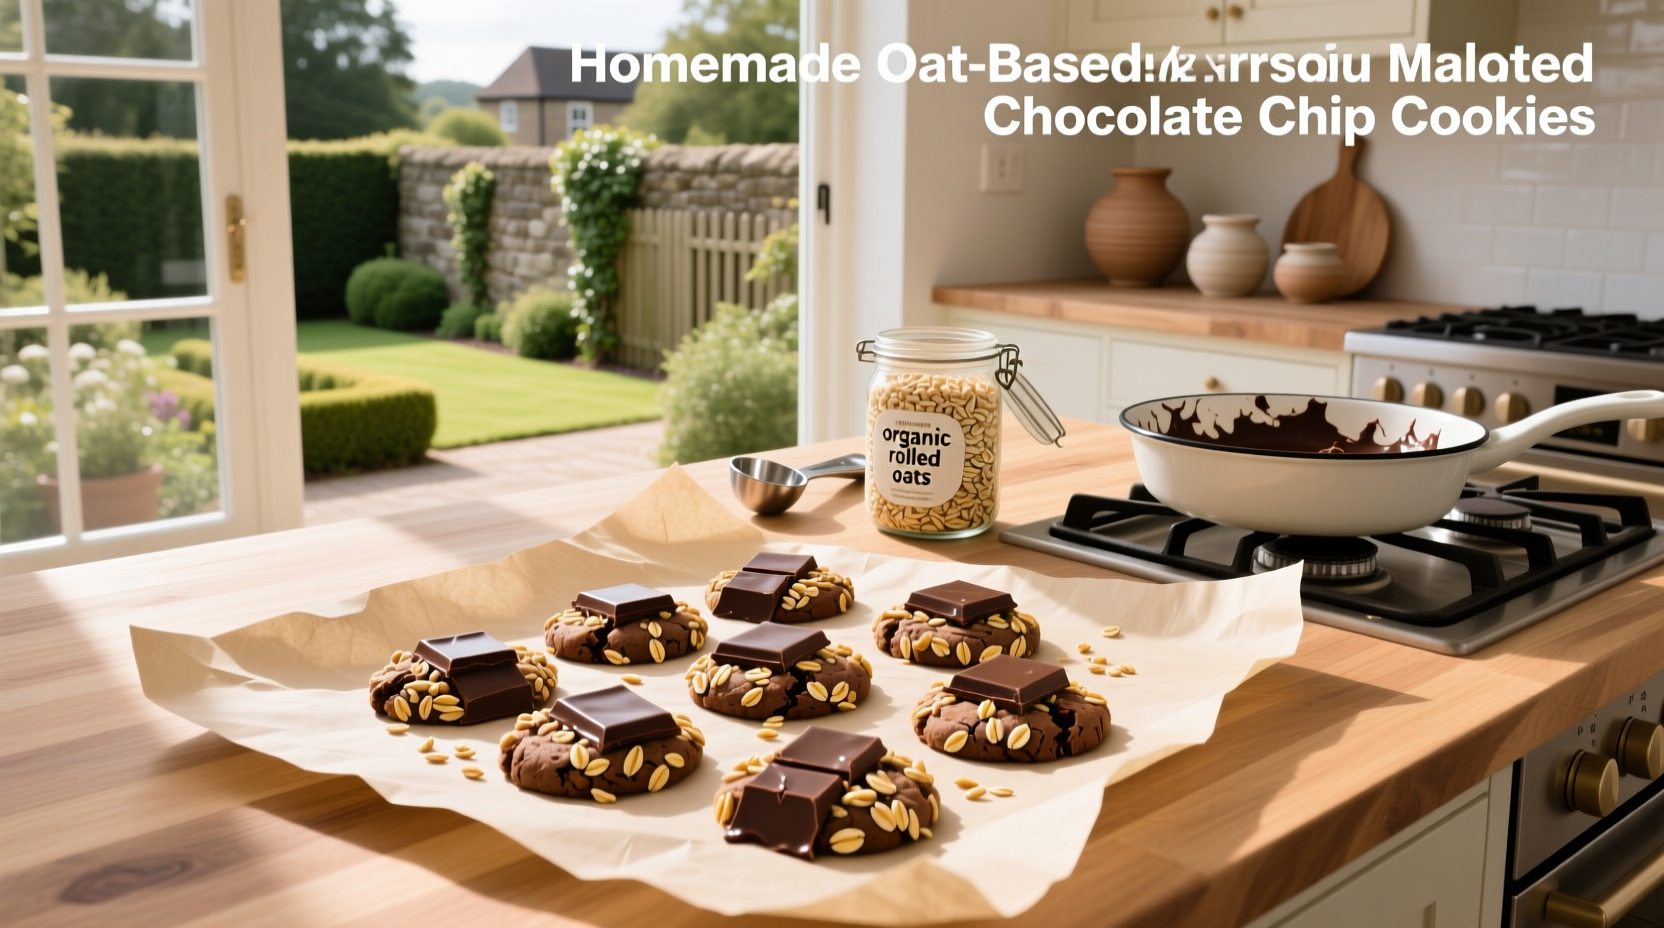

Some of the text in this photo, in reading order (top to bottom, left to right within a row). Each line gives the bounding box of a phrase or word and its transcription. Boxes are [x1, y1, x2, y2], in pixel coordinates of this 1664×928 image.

[882, 427, 952, 449] organic
[889, 447, 941, 467] rolled
[892, 469, 932, 486] oats
